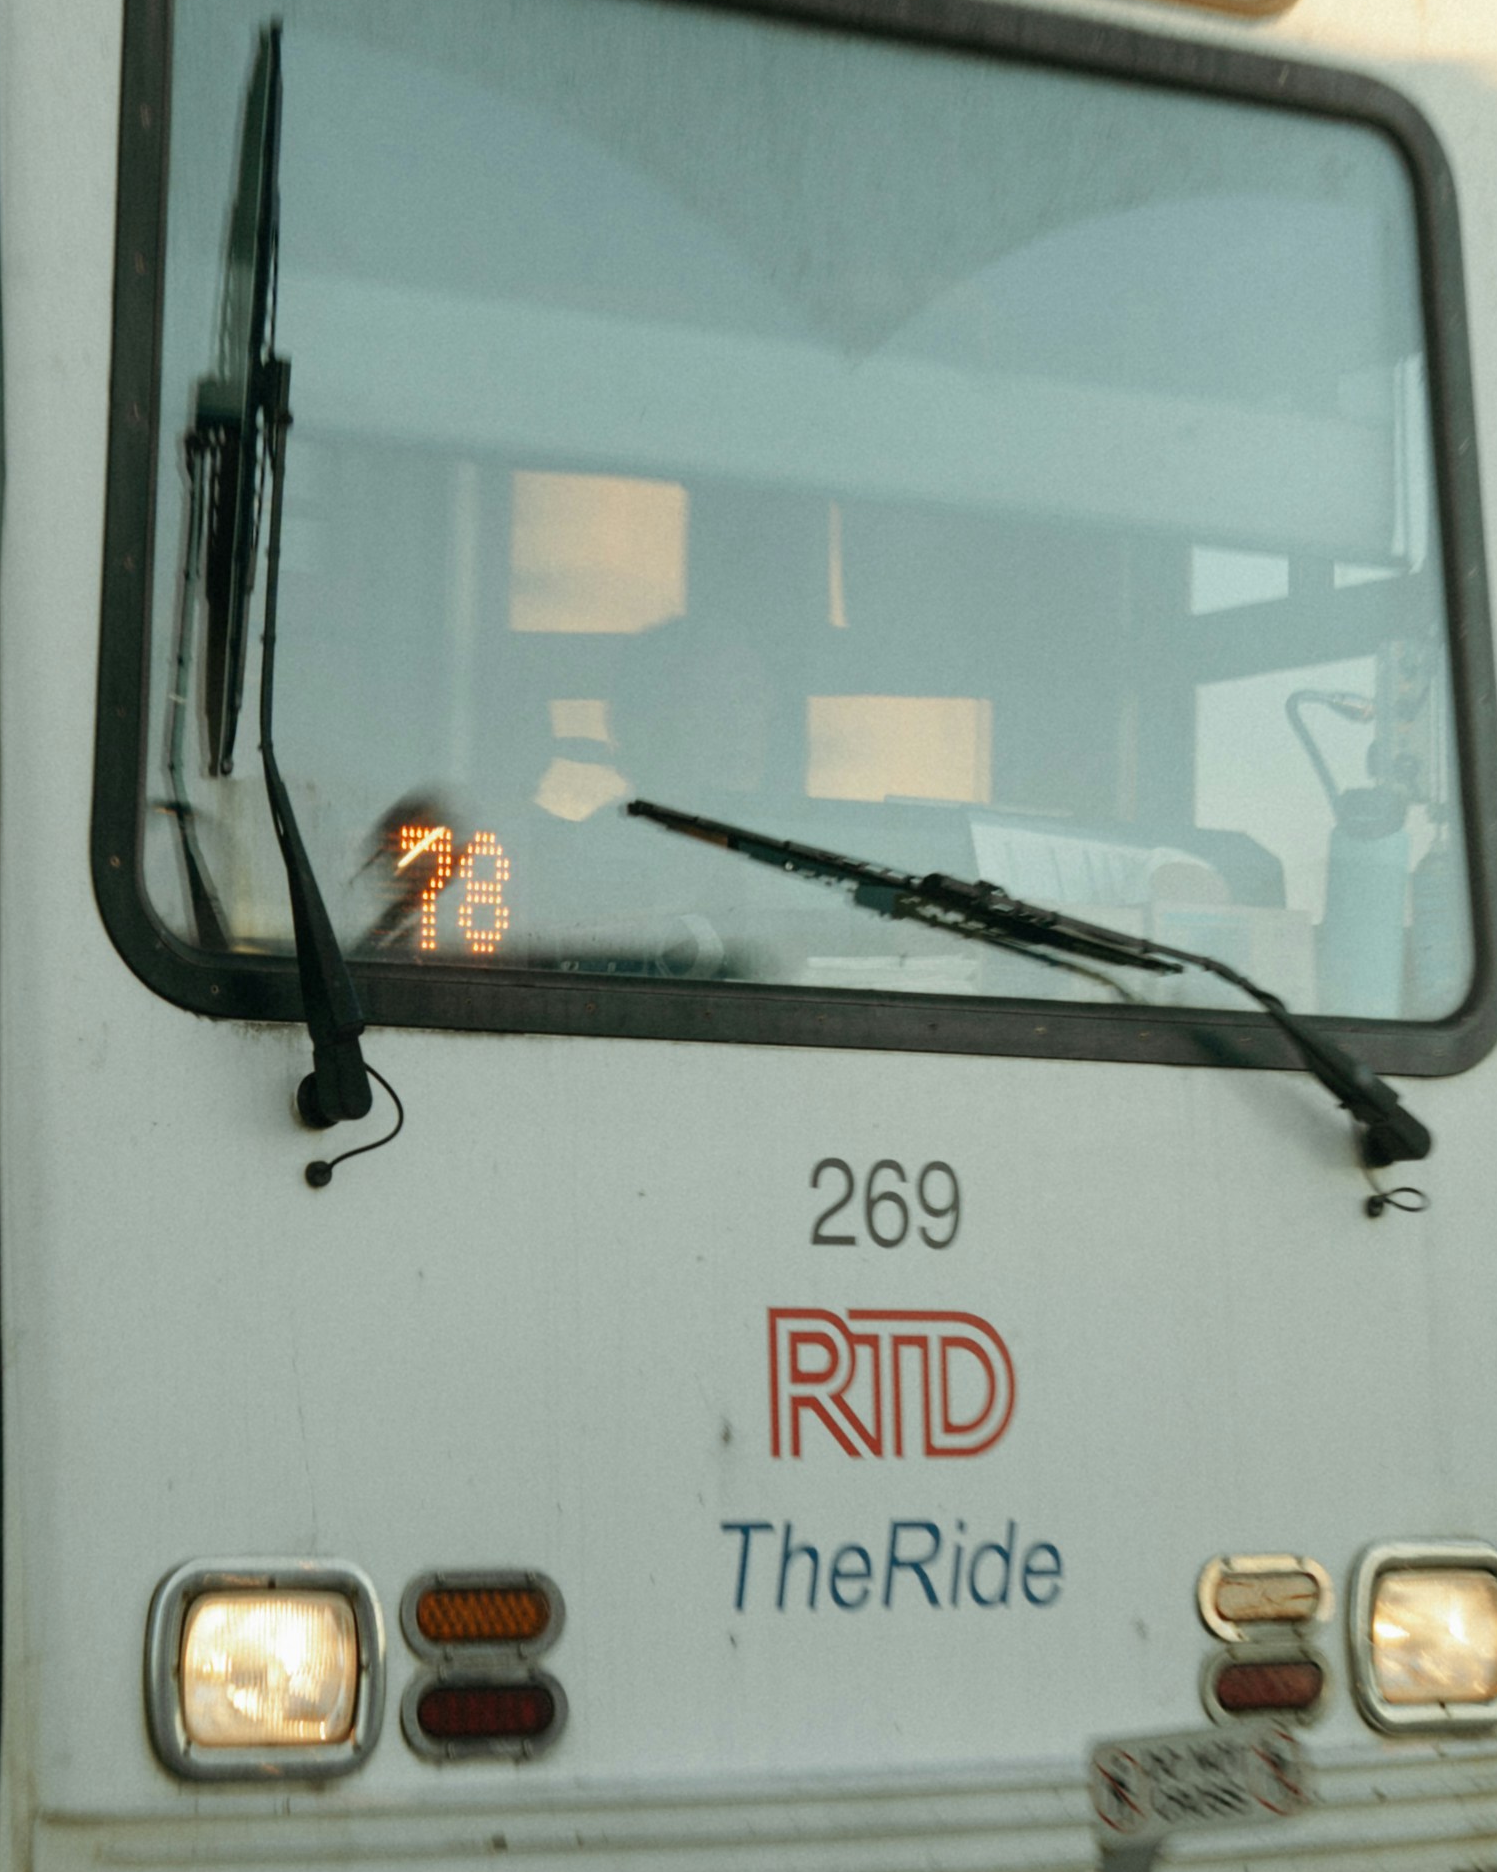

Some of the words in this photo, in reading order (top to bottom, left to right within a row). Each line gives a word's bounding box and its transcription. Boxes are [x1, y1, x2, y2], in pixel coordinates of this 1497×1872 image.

[400, 825, 509, 953] 78
[809, 1157, 961, 1250] 269
[767, 1306, 1016, 1459] RTD
